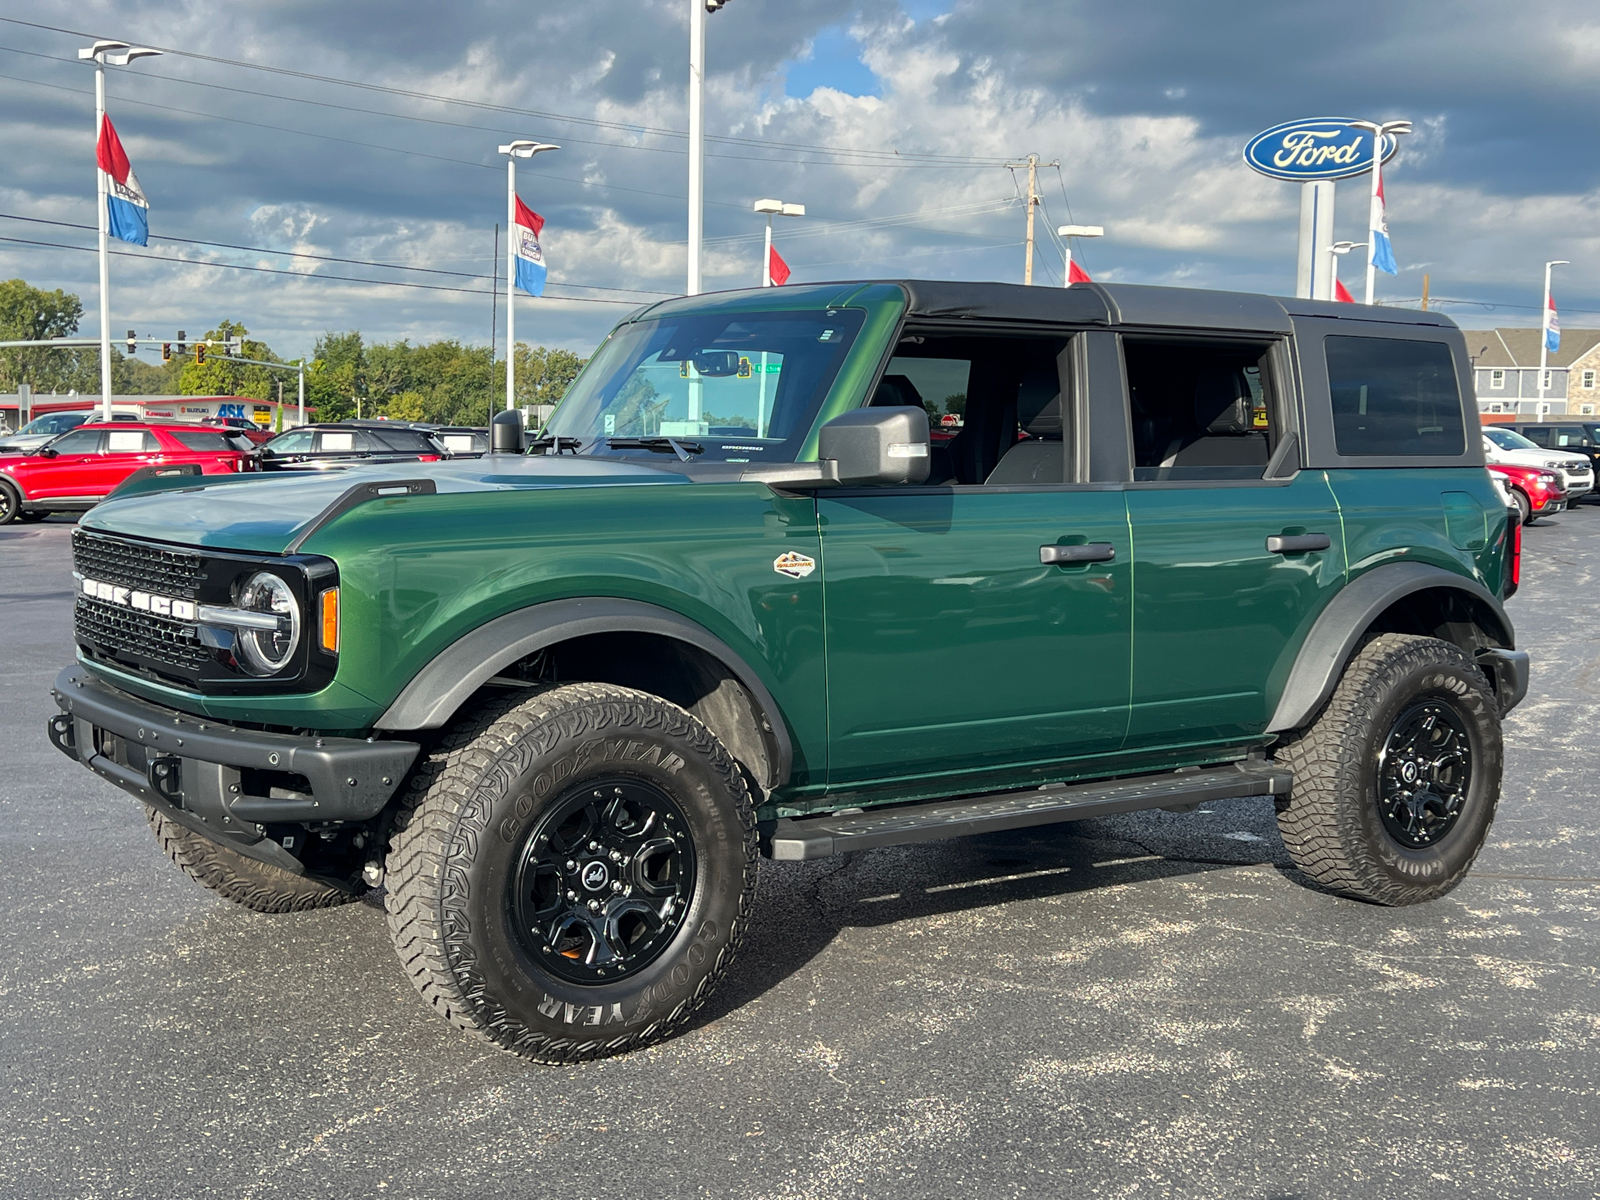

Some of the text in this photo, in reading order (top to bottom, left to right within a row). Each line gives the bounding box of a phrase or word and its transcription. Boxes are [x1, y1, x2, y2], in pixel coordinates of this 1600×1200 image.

[1273, 130, 1364, 167] Ford
[145, 410, 174, 418] Kawasaki
[217, 403, 245, 418] ASK
[1421, 673, 1496, 765] GOODYEAR
[501, 737, 686, 843] GOODYEAR
[537, 920, 719, 1027] GOODYEAR
